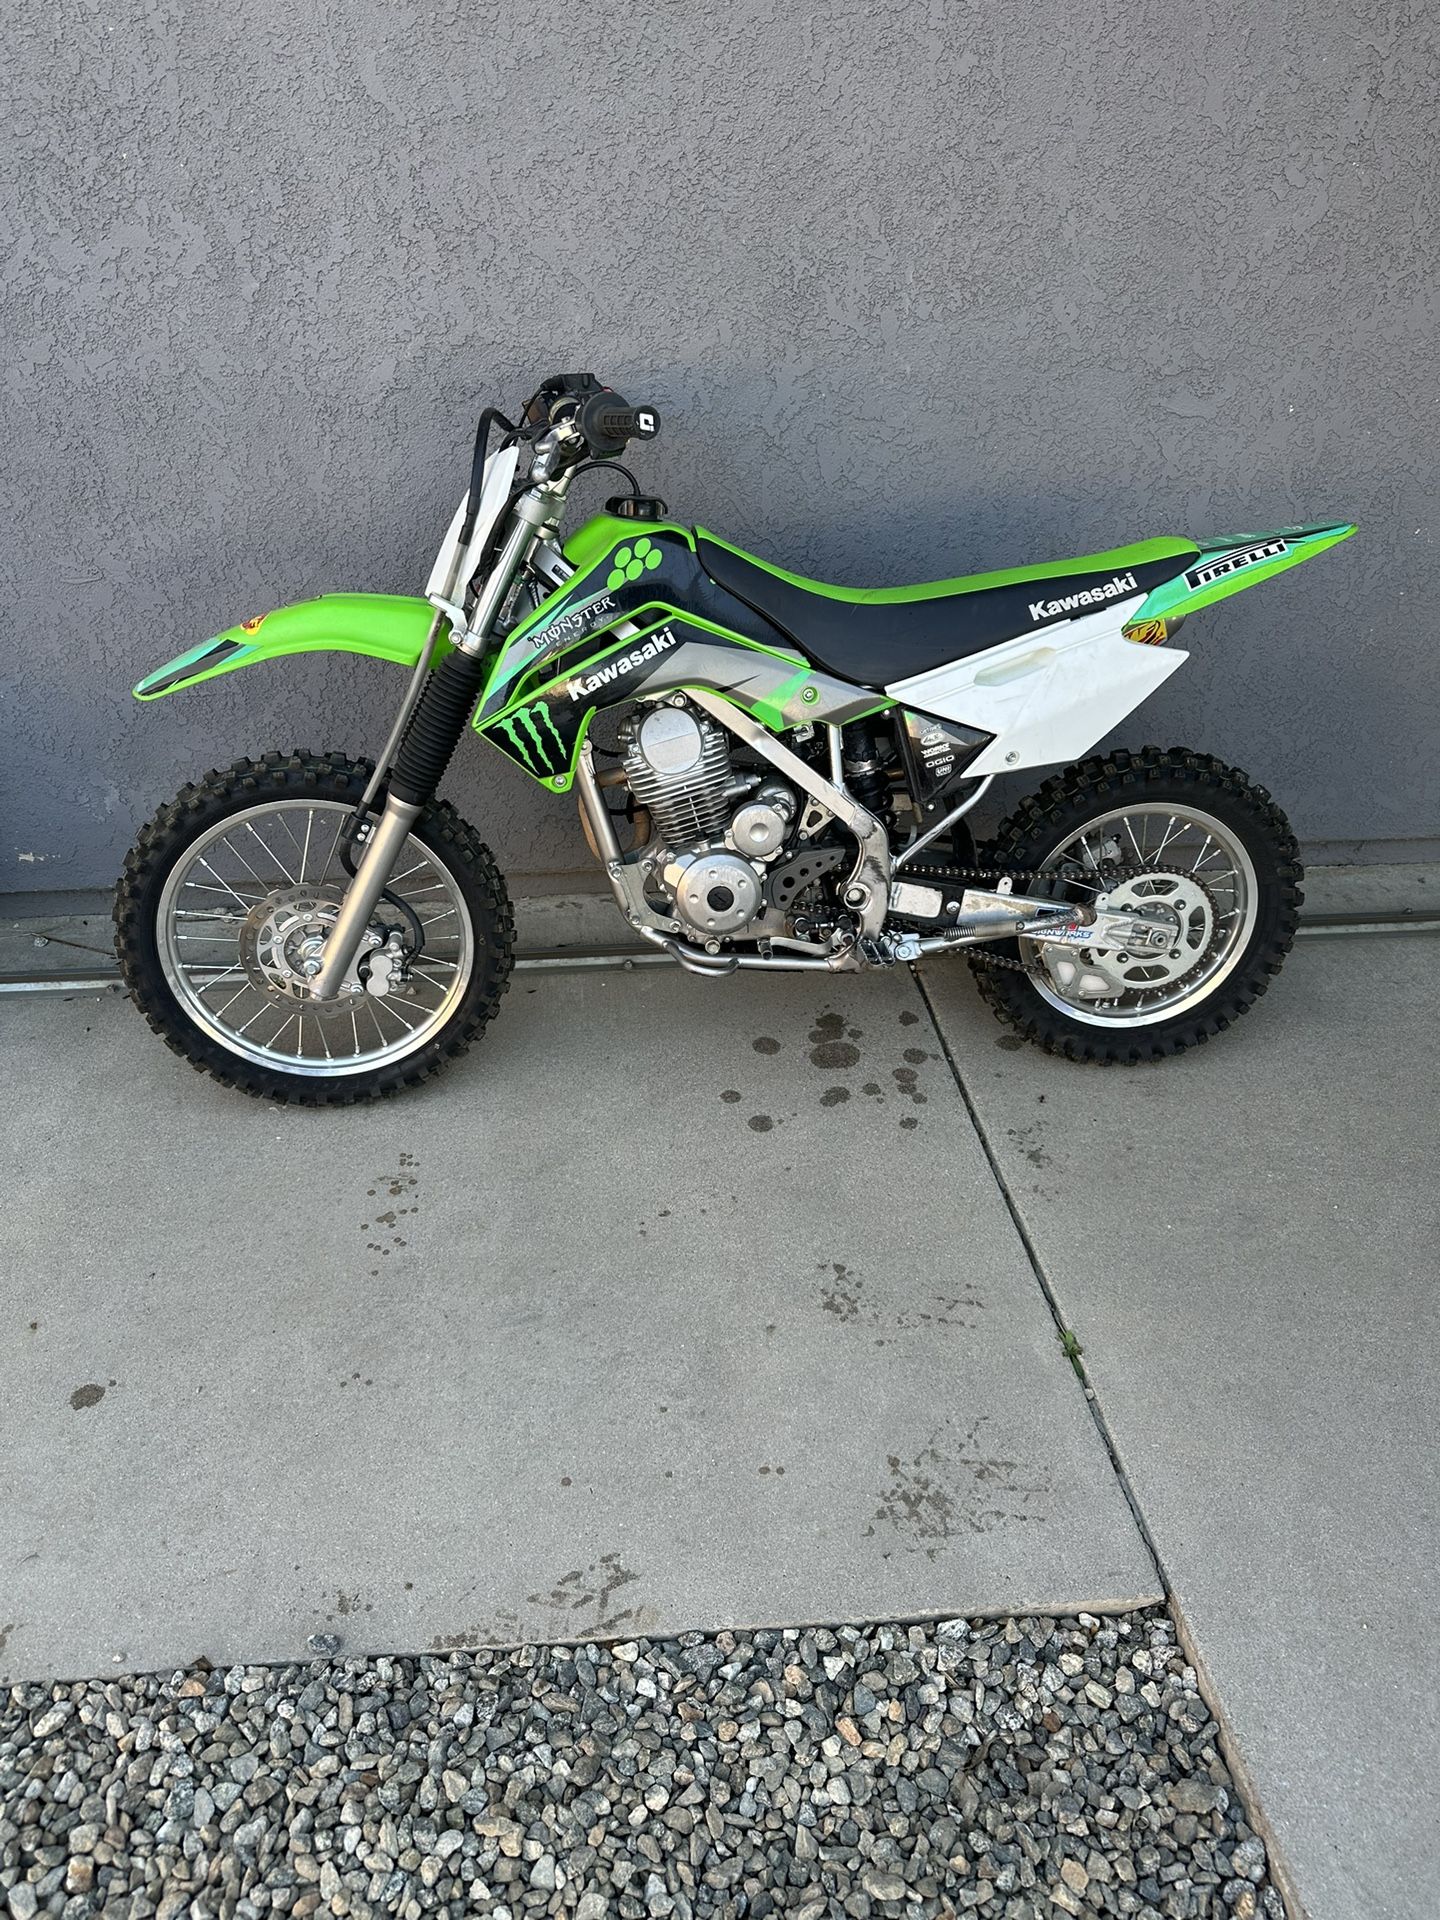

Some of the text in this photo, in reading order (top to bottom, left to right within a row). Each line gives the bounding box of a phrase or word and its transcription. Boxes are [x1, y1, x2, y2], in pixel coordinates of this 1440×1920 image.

[1184, 538, 1287, 590] PIRELLI
[532, 596, 616, 648] MONSTER
[1028, 572, 1138, 621] Kawasaki
[565, 626, 677, 702] Kawasaki
[925, 754, 955, 768] OGIO
